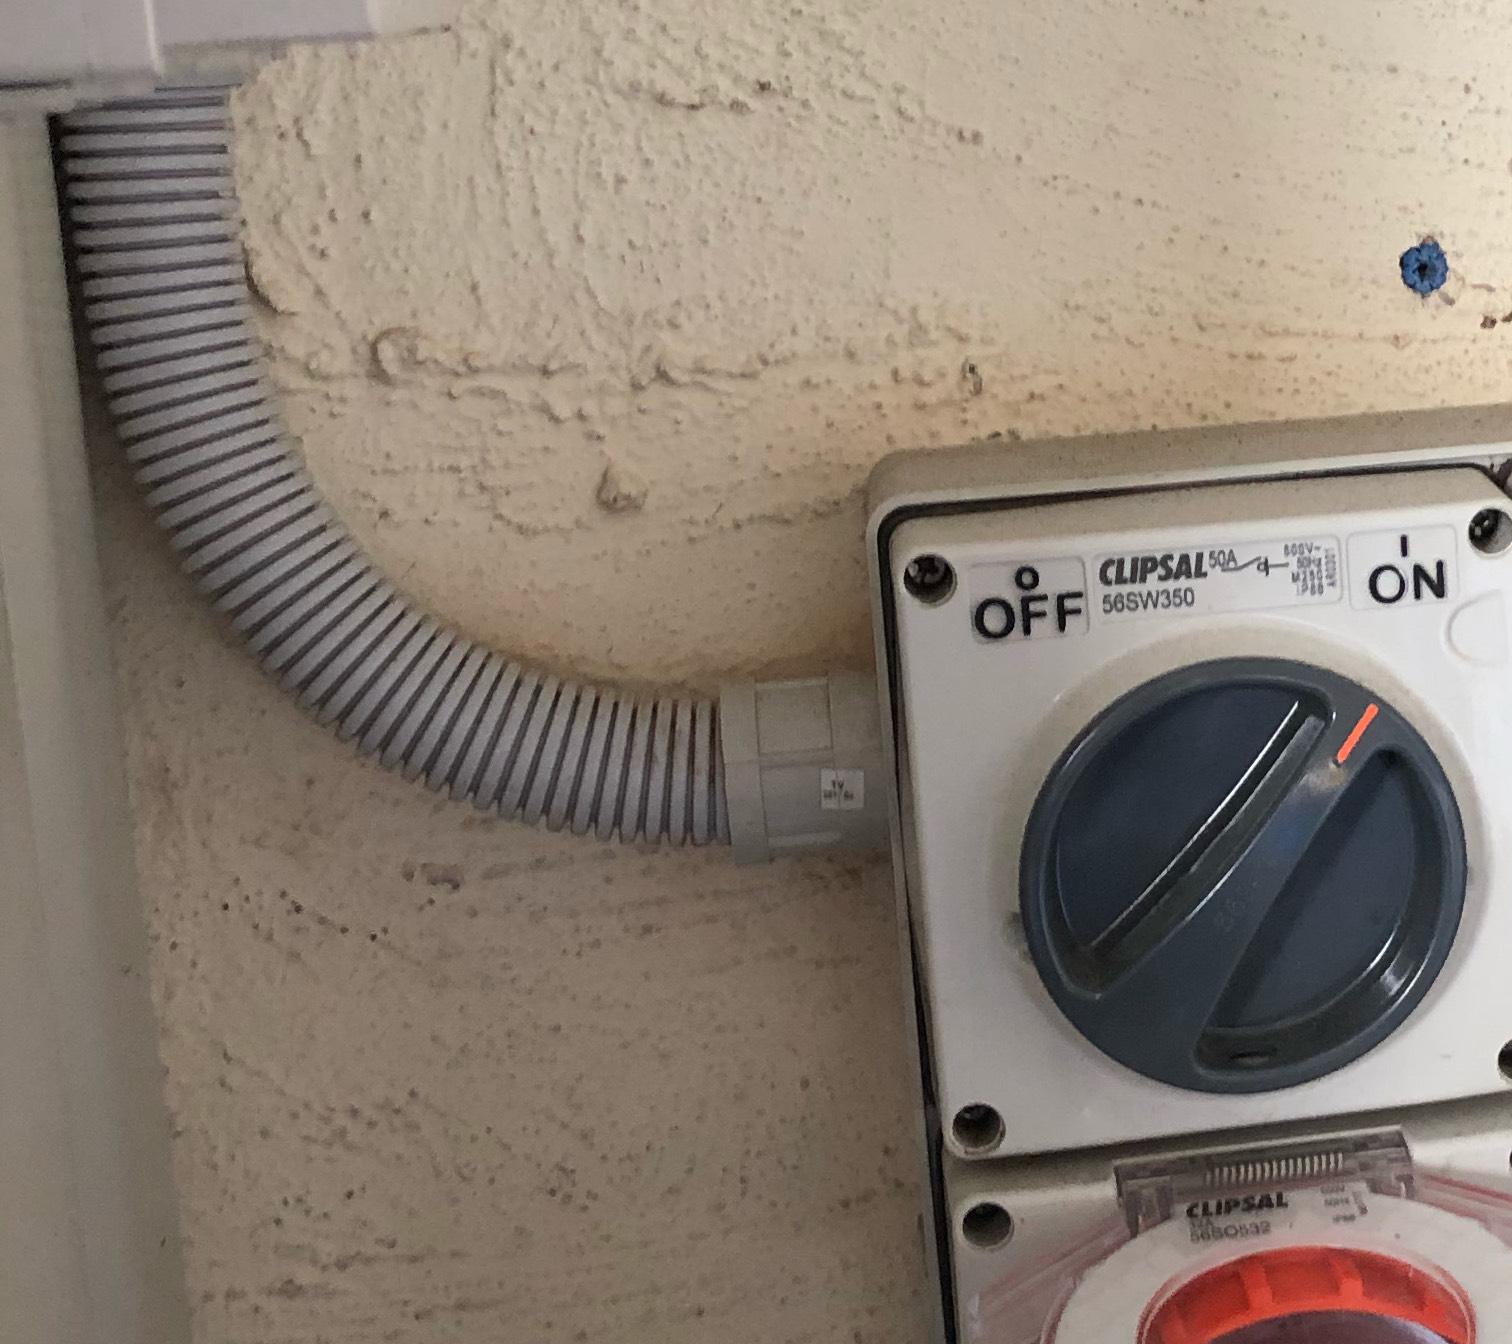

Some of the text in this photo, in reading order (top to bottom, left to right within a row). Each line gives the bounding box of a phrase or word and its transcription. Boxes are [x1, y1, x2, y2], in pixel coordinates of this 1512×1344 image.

[1099, 548, 1239, 586] CLIPSAL 50A
[1368, 559, 1446, 605] ON
[974, 591, 1084, 639] OFF
[1101, 587, 1196, 615] 56SW350
[1186, 1192, 1289, 1218] CLIPSAL
